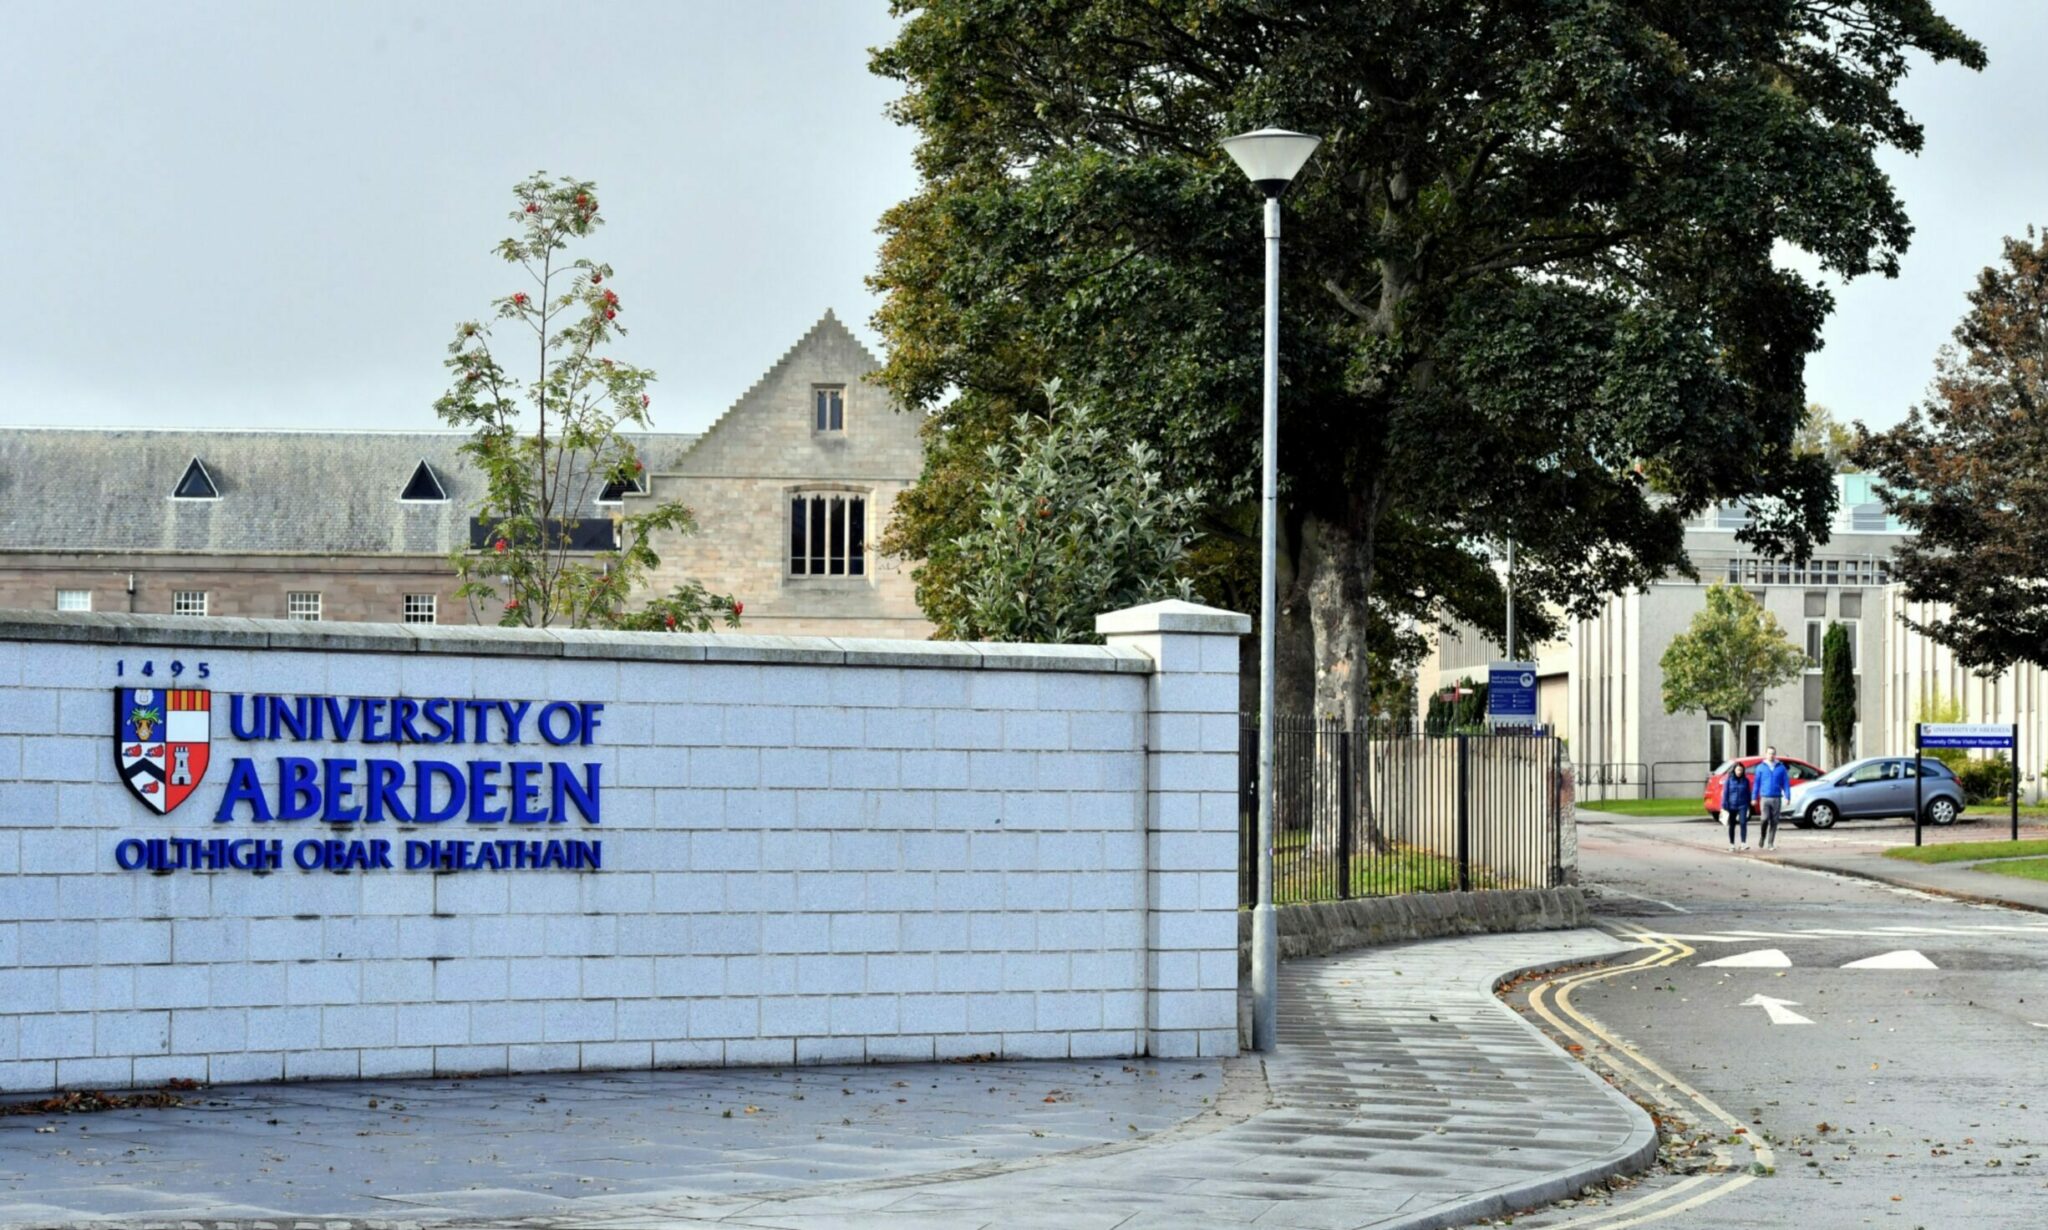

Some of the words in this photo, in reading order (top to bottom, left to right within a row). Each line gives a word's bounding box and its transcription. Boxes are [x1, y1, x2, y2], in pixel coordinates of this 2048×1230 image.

[230, 694, 531, 744] UNIVERSITY
[538, 701, 604, 746] OF
[214, 757, 602, 824] ABERDEEN
[115, 838, 283, 871] OILTHIGH
[293, 838, 393, 871] OBAR
[405, 840, 602, 871] DHEATHAIN
